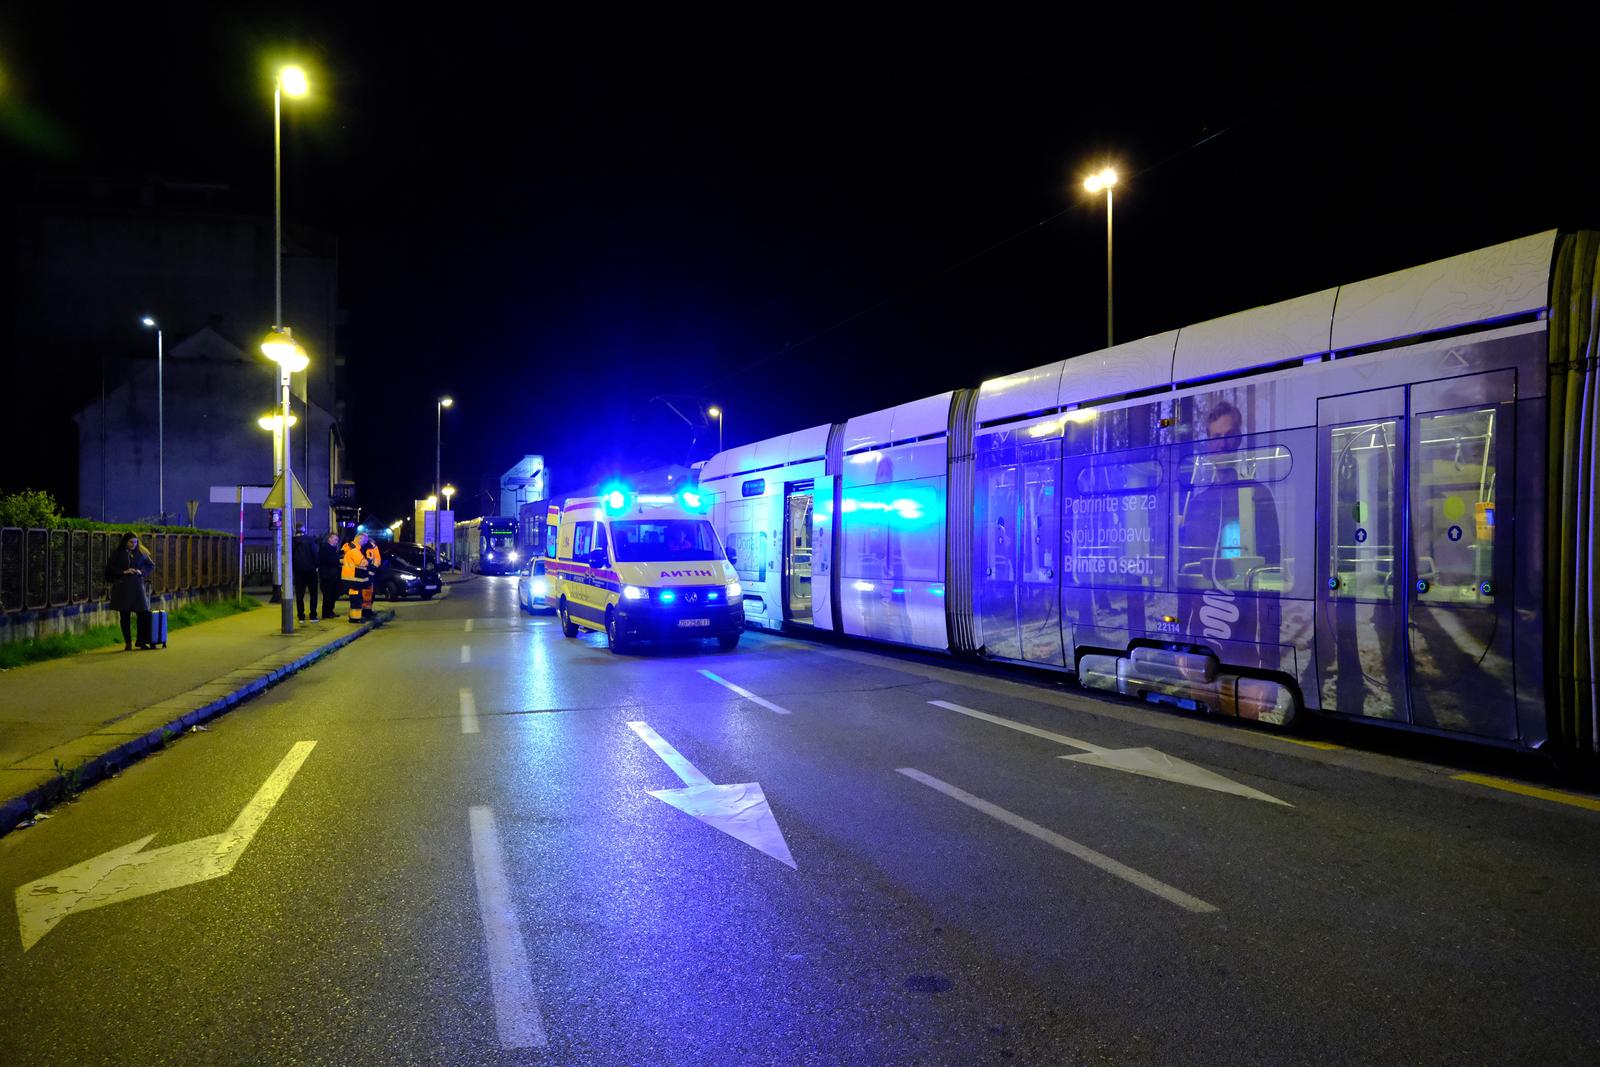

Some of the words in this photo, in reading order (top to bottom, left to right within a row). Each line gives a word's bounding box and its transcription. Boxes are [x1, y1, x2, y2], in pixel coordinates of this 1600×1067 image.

[1064, 494, 1118, 514] Pobrinite
[1121, 495, 1137, 511] se
[1140, 494, 1157, 510] za
[1064, 525, 1095, 549] svoju
[1098, 521, 1155, 547] probavu.
[1064, 554, 1106, 573] Brinite
[1119, 553, 1154, 575] sebi.
[1157, 622, 1180, 633] 22114
